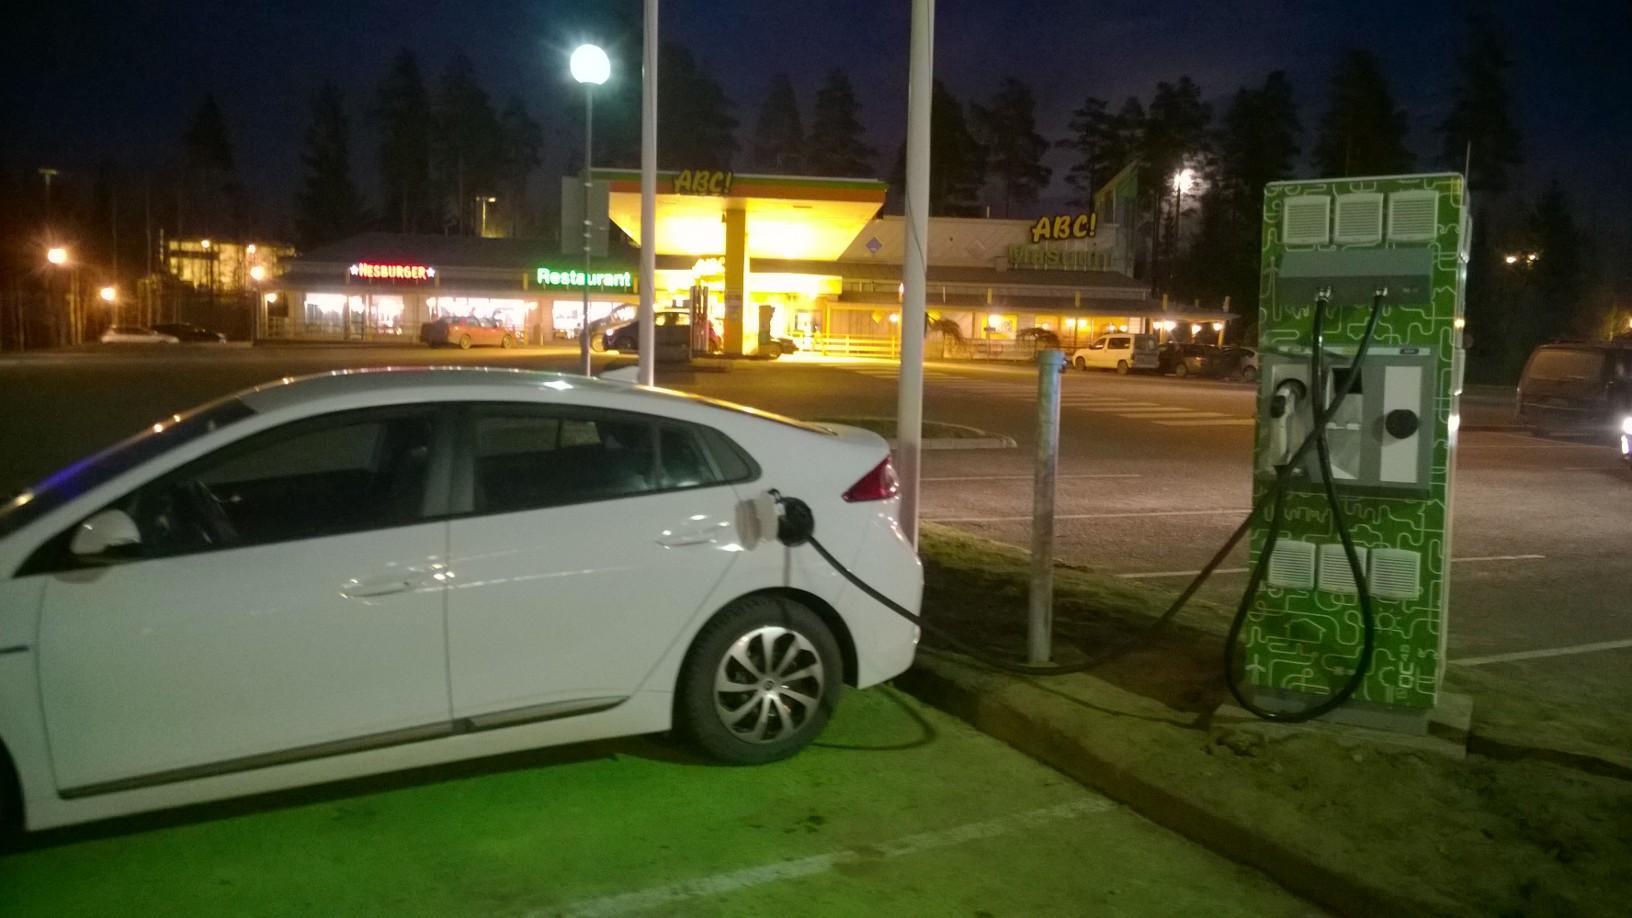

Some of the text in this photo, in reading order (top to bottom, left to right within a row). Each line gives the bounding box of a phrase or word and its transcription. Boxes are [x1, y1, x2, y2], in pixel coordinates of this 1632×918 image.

[674, 169, 732, 194] ABC!
[1031, 213, 1097, 242] ABC!
[359, 263, 427, 280] HESBURGER
[537, 267, 631, 287] Restaurant
